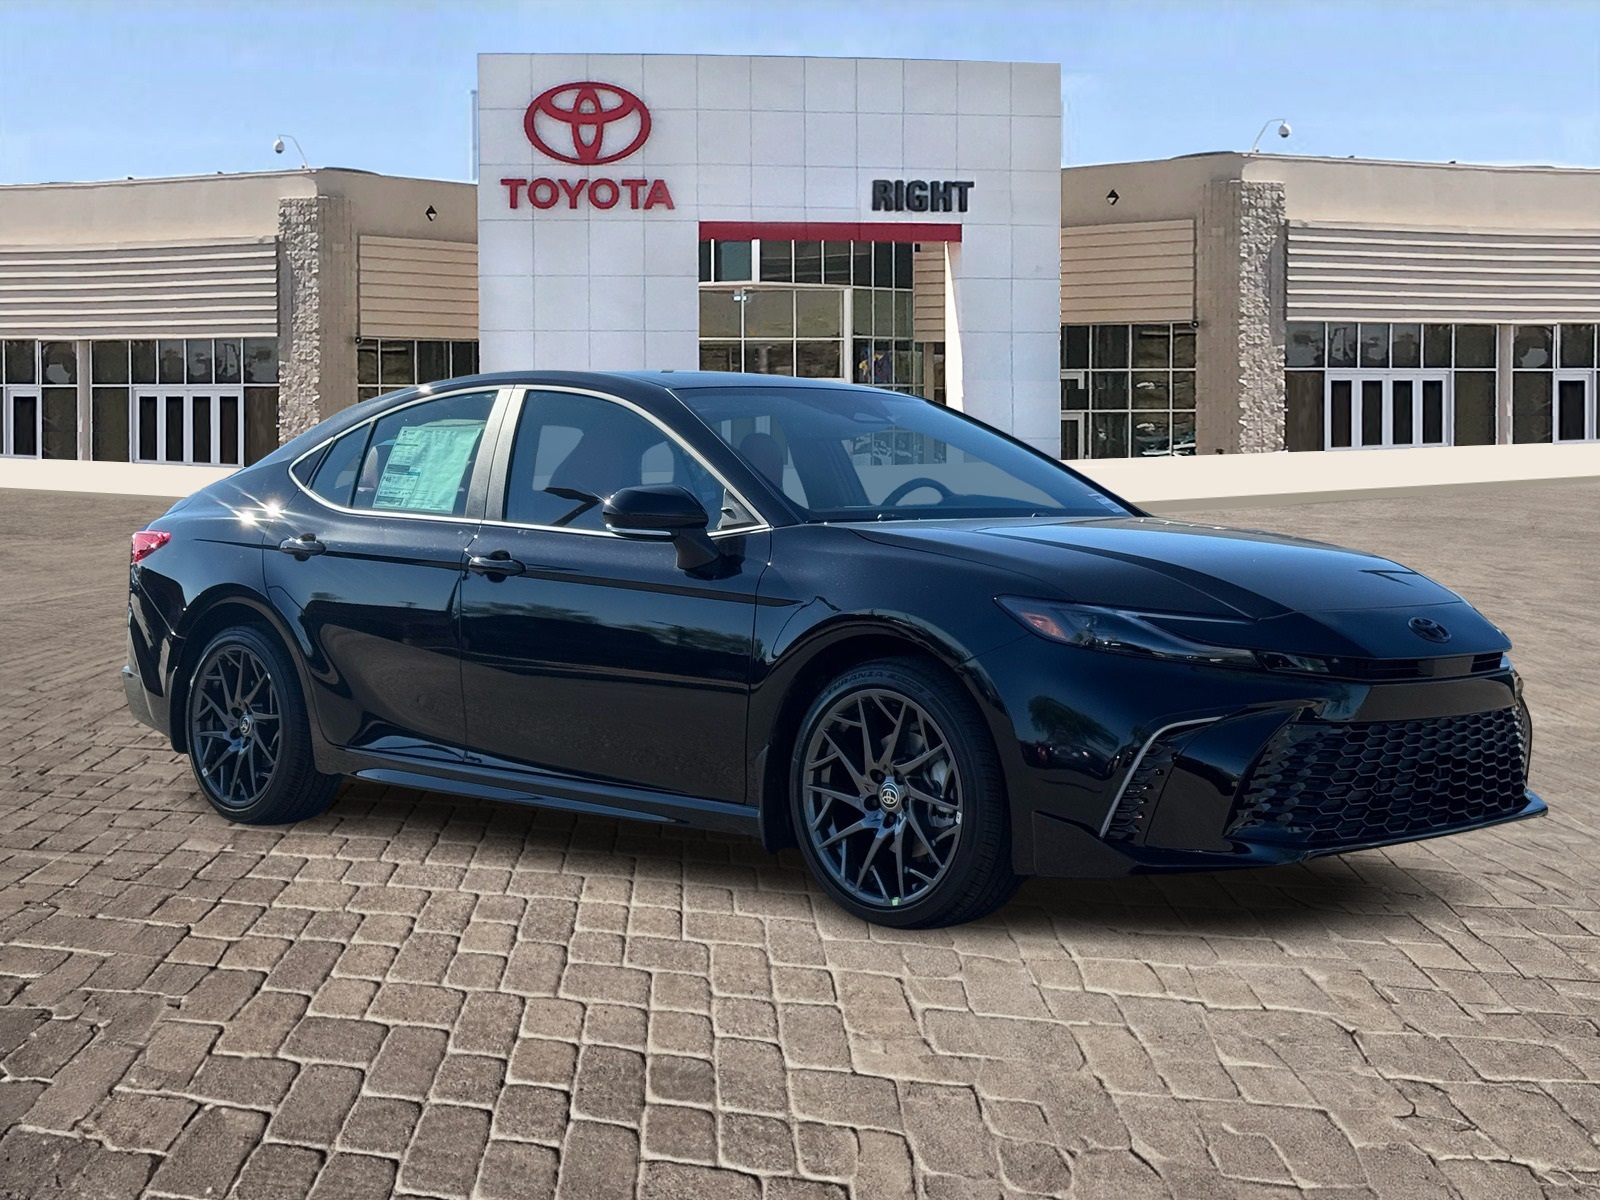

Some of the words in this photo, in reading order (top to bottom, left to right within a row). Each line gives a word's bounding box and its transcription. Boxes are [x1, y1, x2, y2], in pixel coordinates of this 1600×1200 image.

[500, 178, 676, 210] TOYOTA
[871, 179, 975, 213] RIGHT
[827, 671, 884, 694] TURANZA
